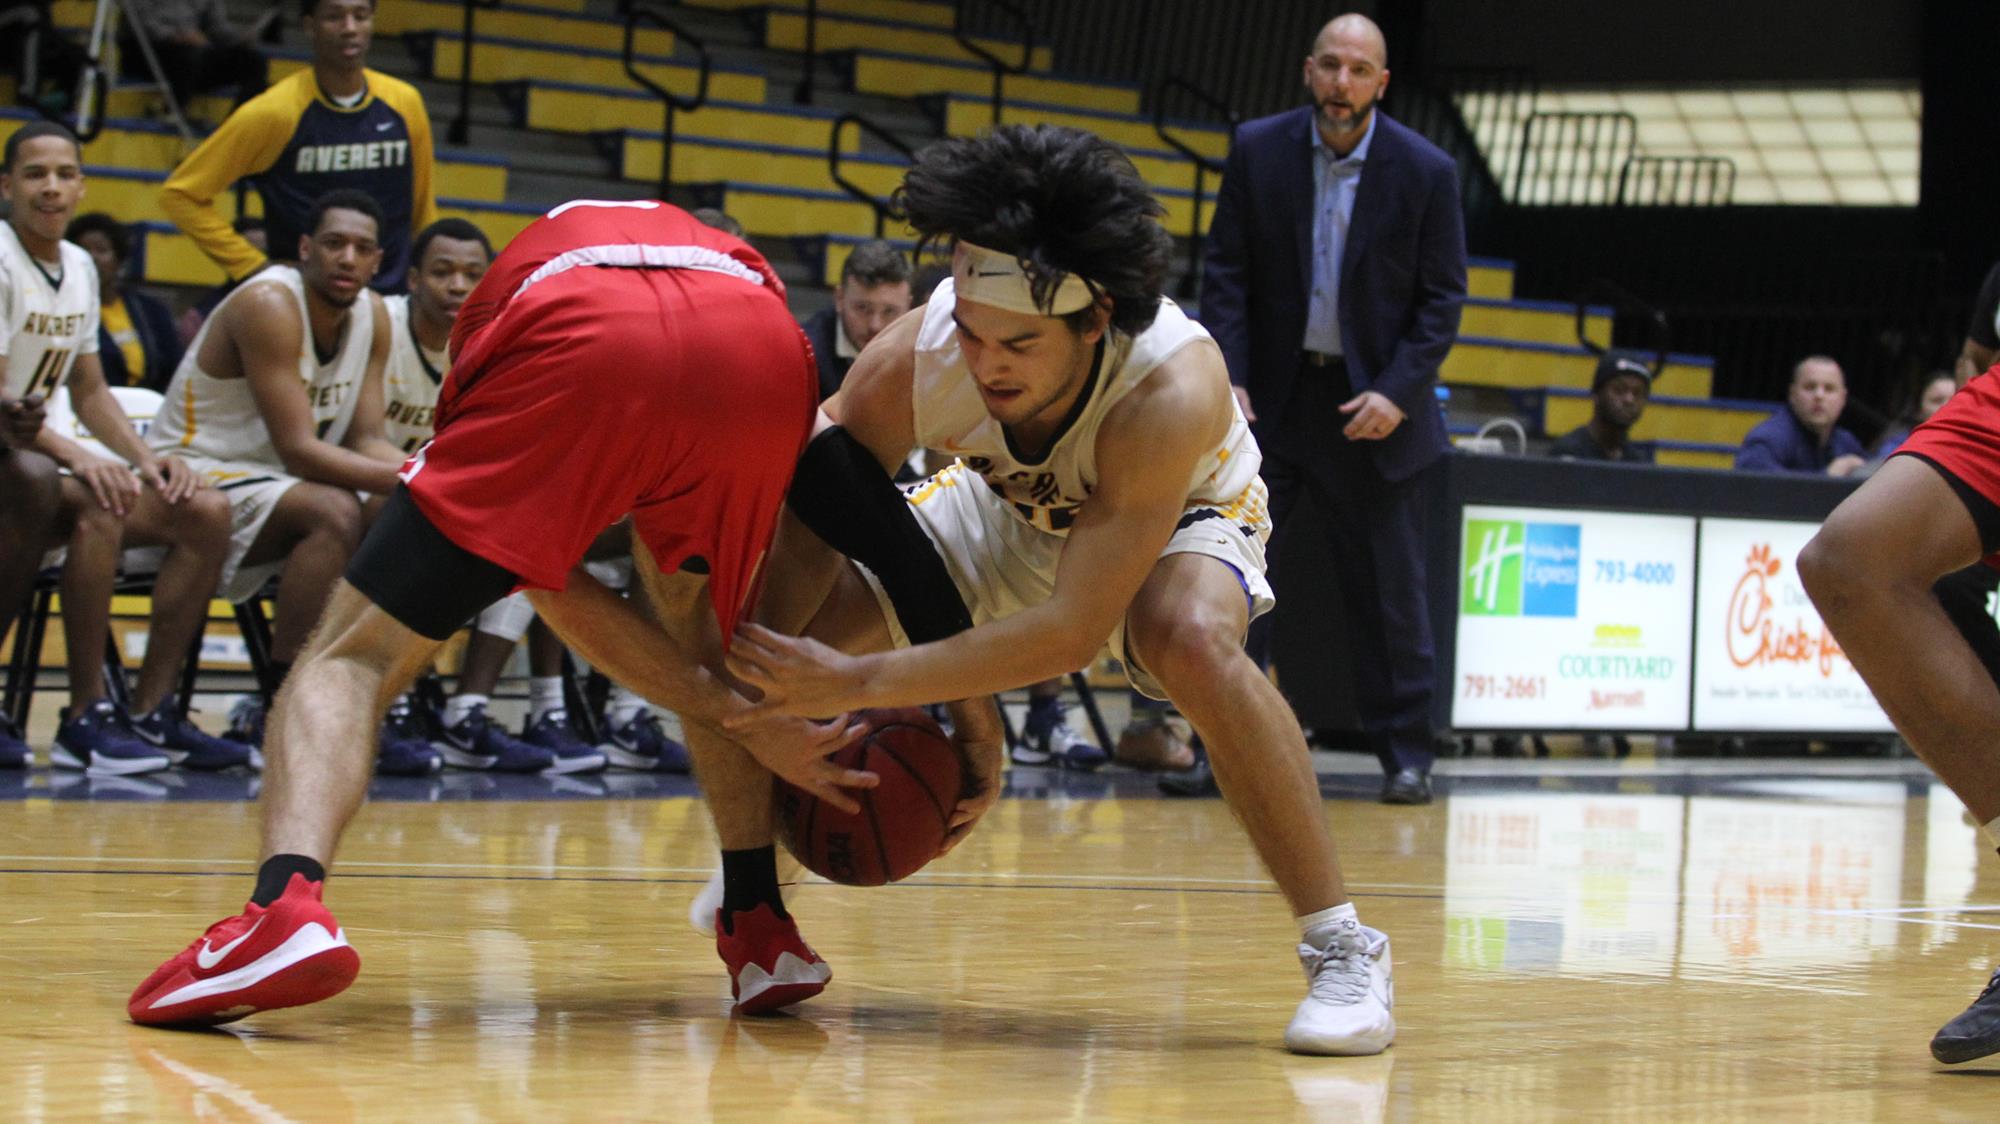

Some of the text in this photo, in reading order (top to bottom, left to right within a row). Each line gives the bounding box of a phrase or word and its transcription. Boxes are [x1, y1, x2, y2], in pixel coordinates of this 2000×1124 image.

[296, 140, 408, 173] AVERETT
[23, 349, 71, 400] 14
[1595, 560, 1675, 585] 793-4000
[1558, 655, 1673, 679] COURTYARD
[1463, 673, 1547, 700] 791-2661
